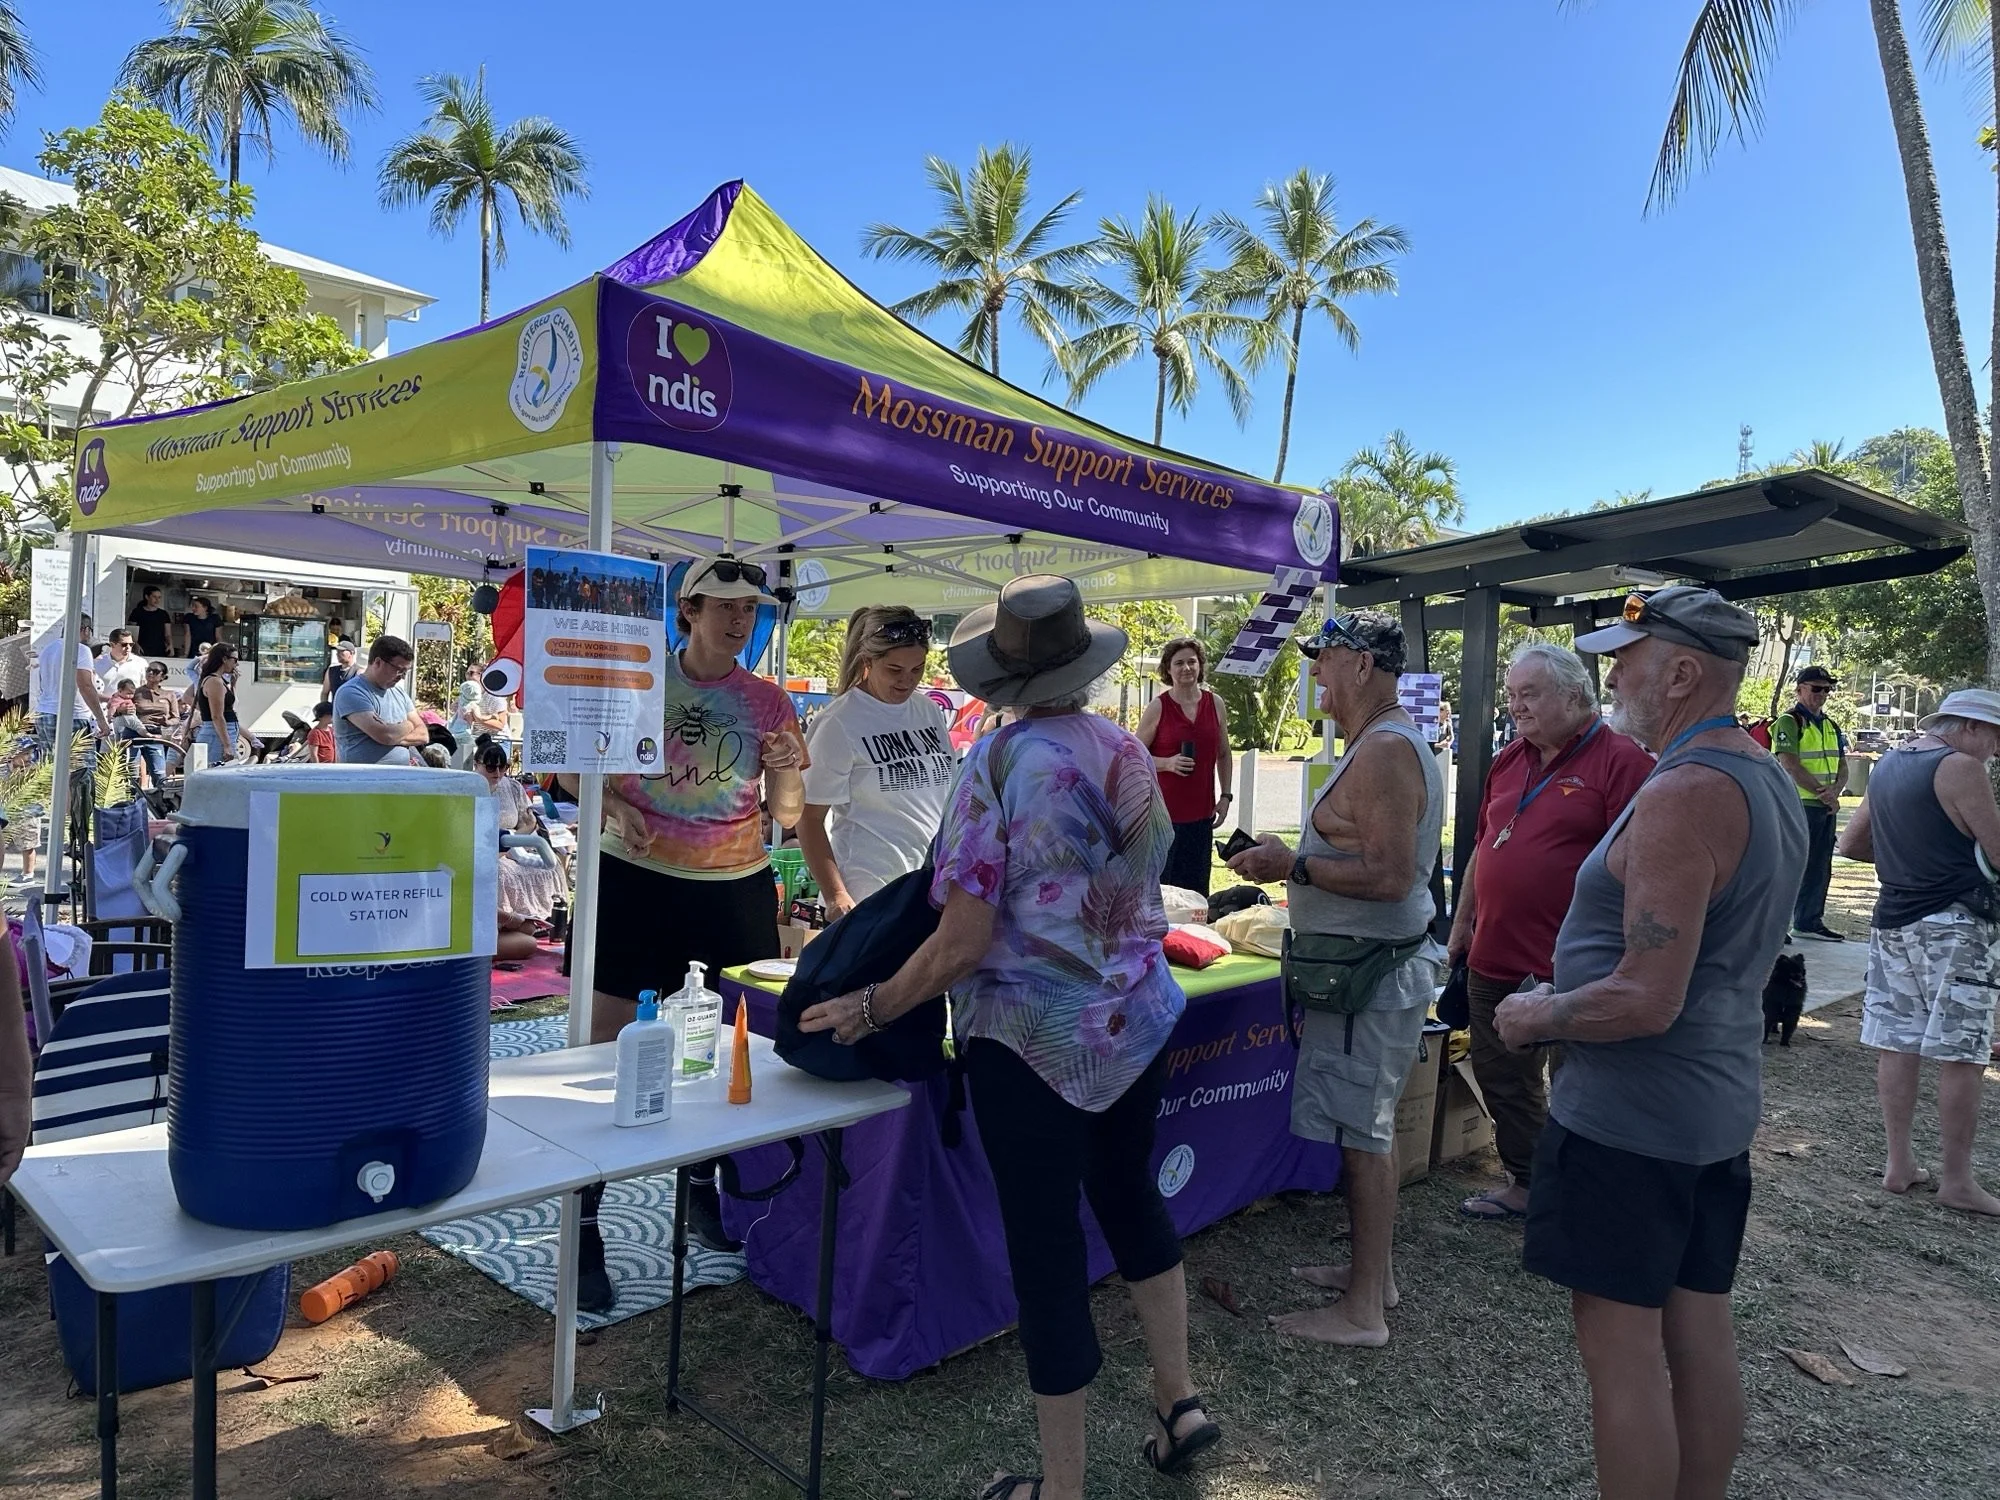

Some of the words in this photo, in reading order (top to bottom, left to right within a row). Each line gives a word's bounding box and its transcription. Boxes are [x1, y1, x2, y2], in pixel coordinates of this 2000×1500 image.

[519, 314, 551, 379] REGISTERED
[552, 313, 581, 363] CHARITY
[655, 315, 673, 360] I
[648, 372, 718, 418] ndis
[145, 428, 230, 465] Mossman
[231, 396, 314, 452] Support
[321, 372, 423, 425] Services
[850, 374, 1015, 457] Mossman
[1023, 426, 1135, 487] Support
[1140, 458, 1235, 510] Services
[195, 463, 257, 494] Supporting
[257, 458, 280, 482] Our
[281, 440, 352, 478] Community
[78, 478, 105, 504] ndis
[948, 463, 1053, 509] Supporting
[1052, 487, 1084, 513] Our
[1086, 496, 1170, 536] Community
[553, 617, 579, 630] WE
[581, 619, 609, 633] ARE
[611, 622, 649, 637] HIRING
[552, 640, 582, 649] YOUTH
[584, 642, 618, 652] WORKER
[584, 649, 631, 660] experienced)
[557, 672, 595, 681] VOLUNTEER
[640, 751, 655, 761] ndis
[862, 730, 922, 765] LORNA
[310, 890, 347, 903] COLD
[351, 889, 400, 902] WATER
[403, 887, 443, 899] REFILL
[349, 908, 409, 921] STATION
[1189, 1068, 1290, 1109] Community
